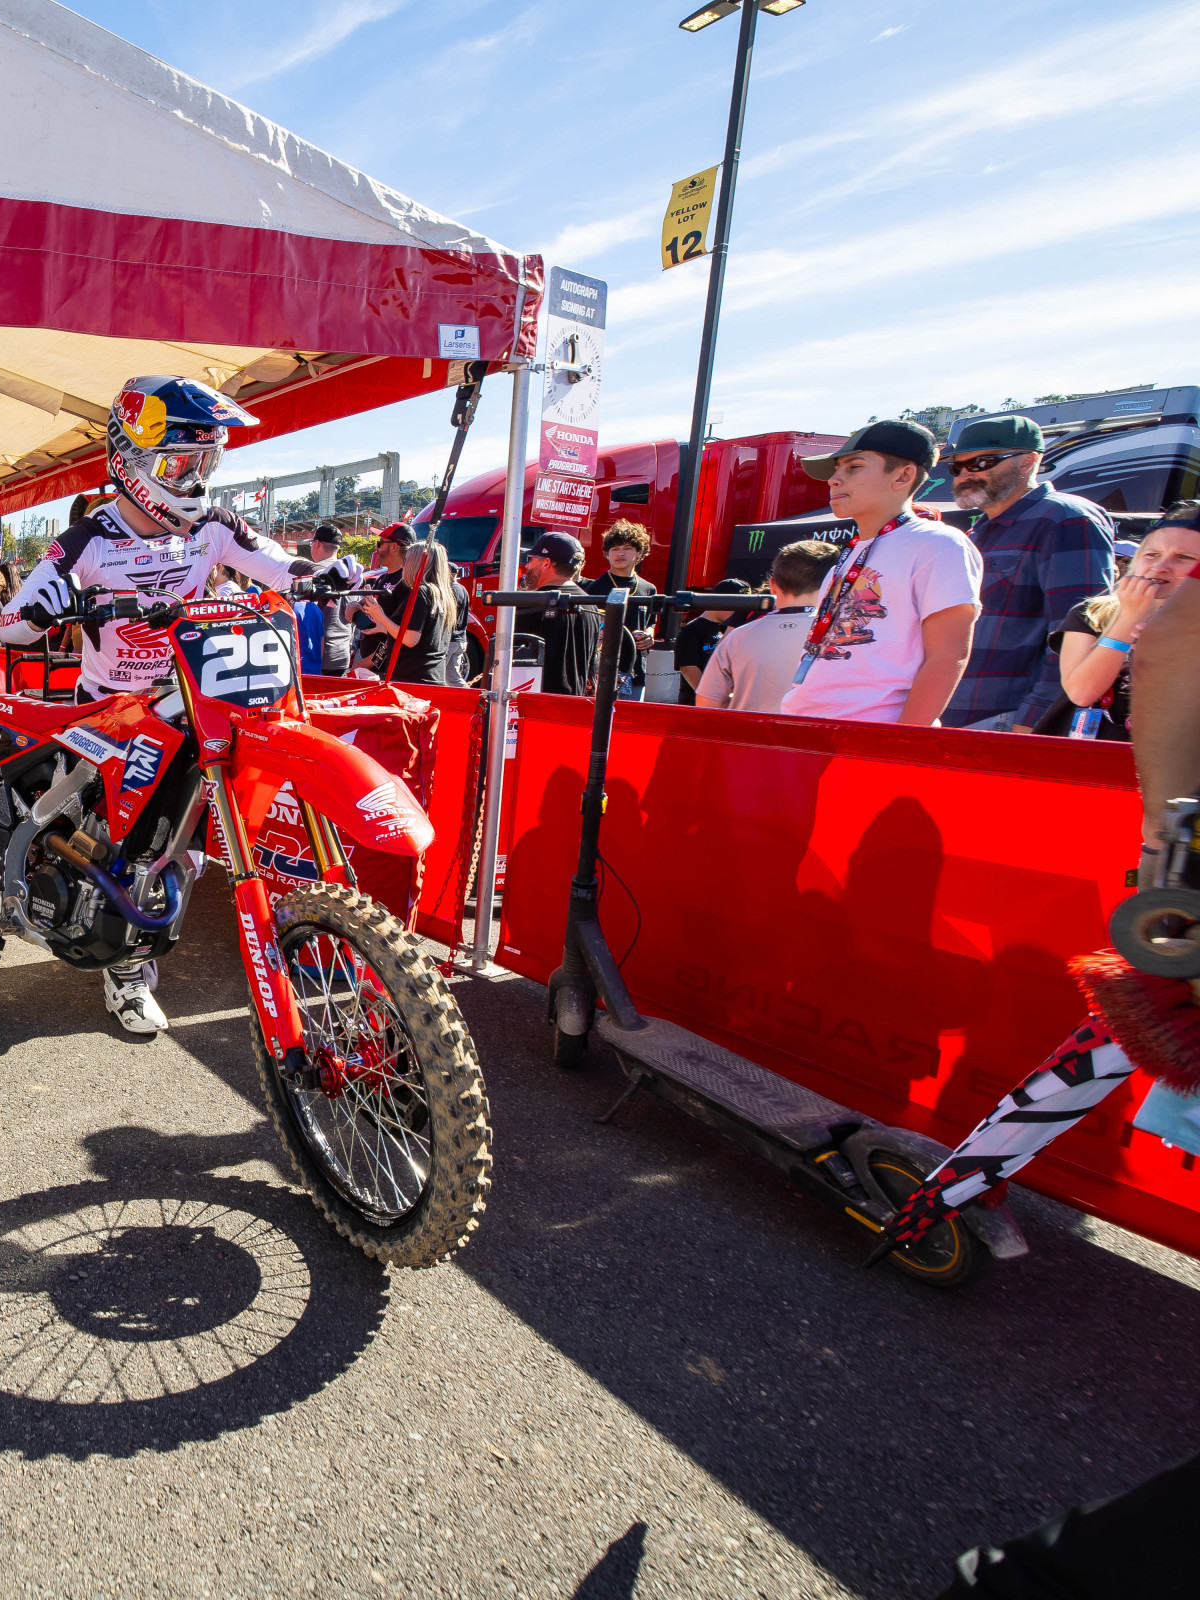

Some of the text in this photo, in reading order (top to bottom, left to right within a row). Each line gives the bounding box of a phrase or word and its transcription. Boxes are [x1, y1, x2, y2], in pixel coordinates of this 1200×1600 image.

[670, 201, 707, 217] YELLOW
[677, 213, 695, 224] LOT
[665, 230, 703, 265] 12
[560, 279, 598, 300] AUTOGRAPH
[561, 300, 596, 319] SIGNING AT
[556, 430, 594, 446] HONDA
[112, 451, 139, 493] Red
[133, 485, 171, 522] Bull
[537, 477, 594, 499] LINE STARTS HERE
[535, 498, 589, 516] WRISTBAND REQUIRED
[97, 514, 120, 534] FLY
[106, 560, 128, 568] SHOWA
[135, 556, 152, 566] 100%
[160, 550, 186, 562] WPS
[189, 602, 256, 616] RENTHAL
[201, 630, 290, 698] 29
[66, 731, 108, 759] PROGRESSIVE
[123, 734, 163, 781] CRF
[363, 808, 416, 822] HONDA
[32, 896, 55, 909] HONDA
[240, 911, 278, 1018] DUNLOP
